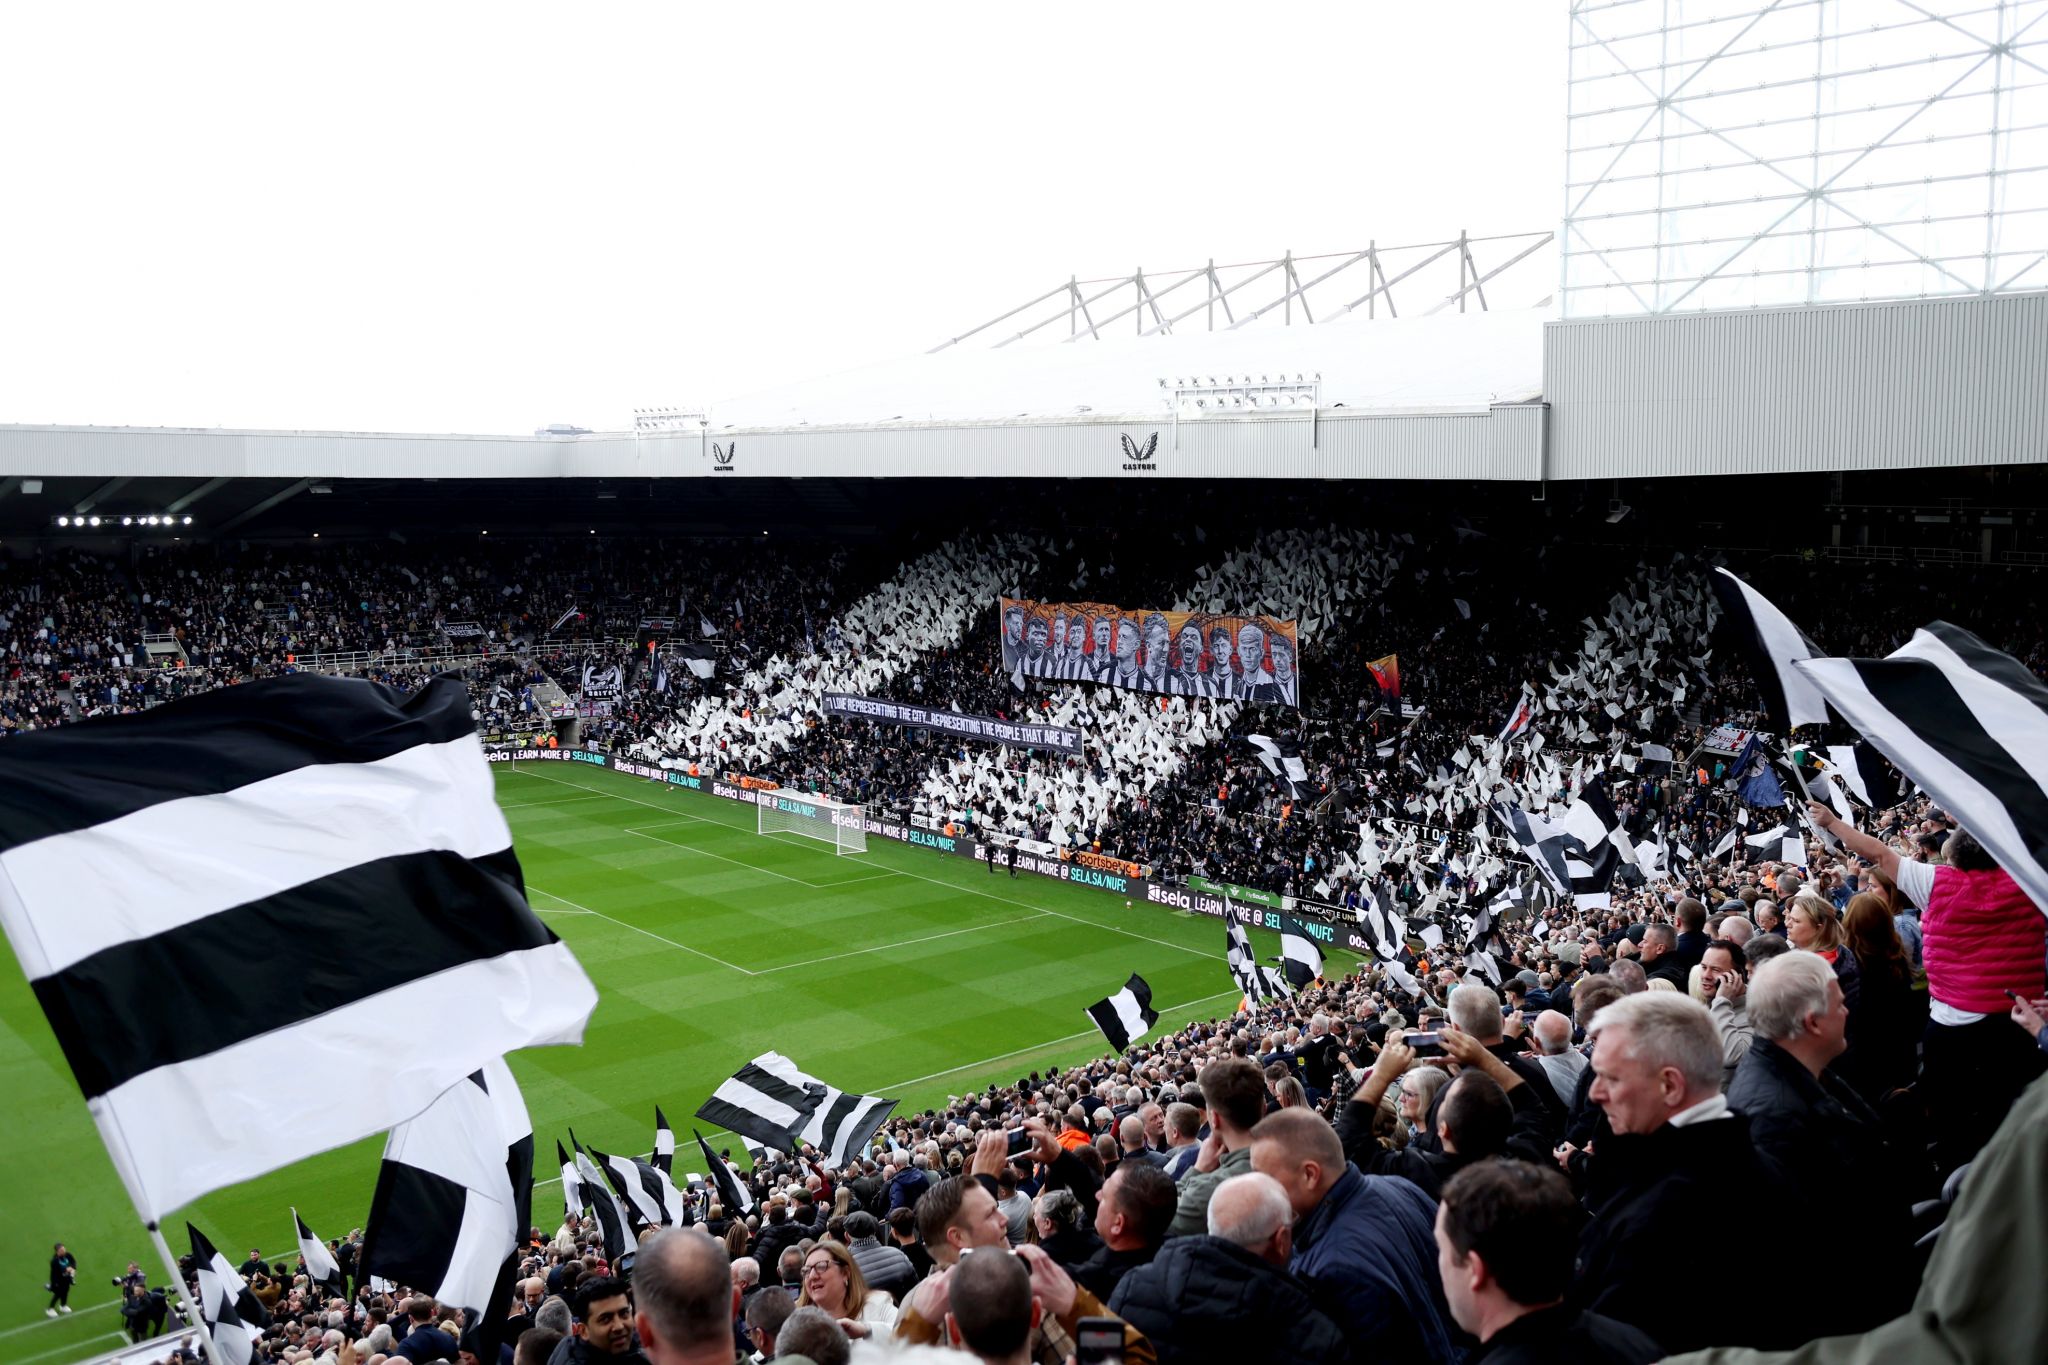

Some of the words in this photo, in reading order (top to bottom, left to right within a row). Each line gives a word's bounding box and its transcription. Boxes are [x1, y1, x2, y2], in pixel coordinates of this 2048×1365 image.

[848, 699, 897, 718] REPRESENTING
[898, 706, 911, 720] THE
[981, 720, 995, 736] THE
[995, 723, 1020, 740] PEOPLE
[1021, 728, 1042, 744] THAT
[1044, 730, 1060, 745] ARE
[483, 750, 510, 762] sela
[514, 750, 539, 760] LEARN
[540, 750, 562, 760] MORE
[563, 750, 570, 760] @
[620, 762, 634, 774] sela
[636, 765, 650, 778] LEARN
[650, 768, 663, 780] MORE
[668, 772, 700, 790] SELA.SA/NUFC
[720, 786, 738, 799] sela
[740, 790, 756, 804] LEARN
[772, 797, 778, 810] @
[778, 798, 816, 818] SELA.SA/NUFC
[840, 815, 860, 830] sela
[862, 820, 882, 834] LEARN
[882, 823, 900, 838] MORE
[902, 828, 908, 842] @
[910, 830, 956, 852] SELA.SA/NUFC
[1038, 858, 1059, 877] MORE
[1060, 866, 1068, 880] @
[1070, 867, 1126, 892] SELA.SA/NUFC
[1161, 888, 1190, 910] sela
[1194, 897, 1222, 916] LEARN
[1253, 910, 1262, 926] @
